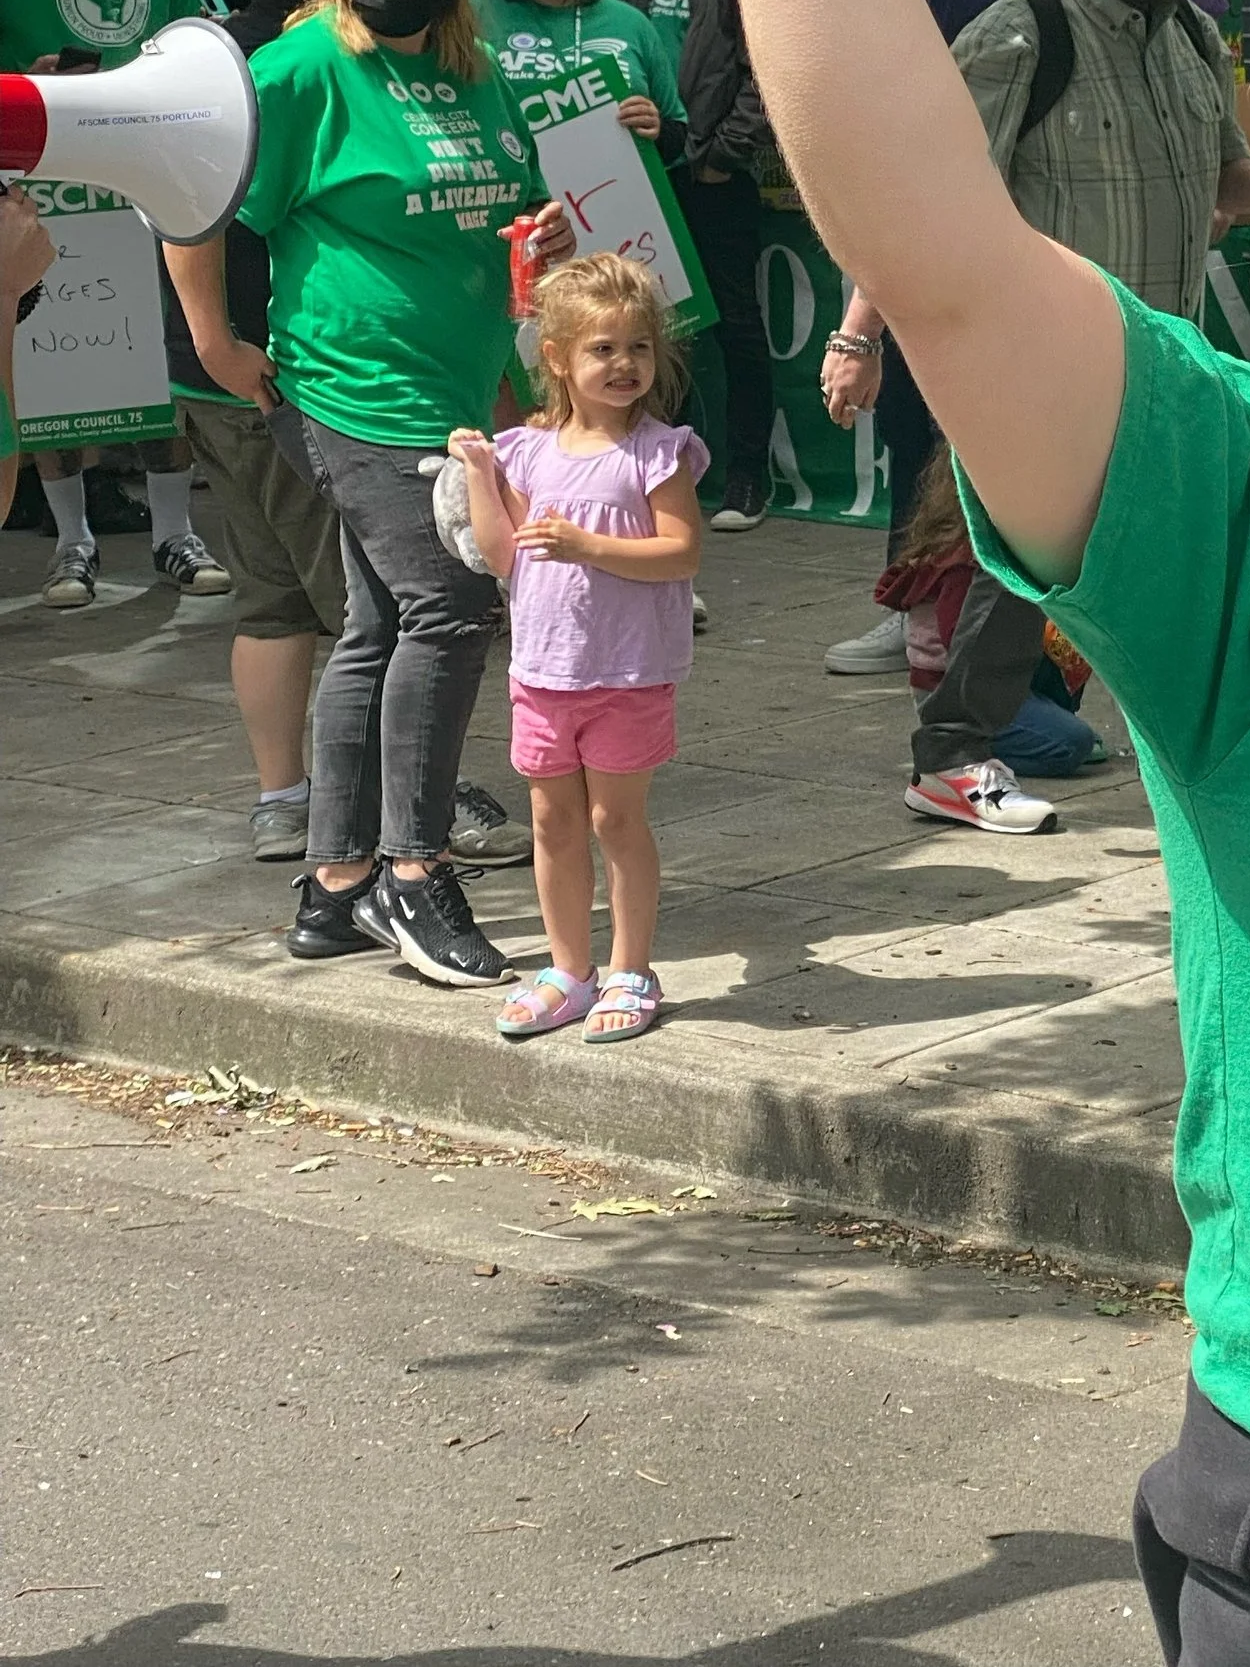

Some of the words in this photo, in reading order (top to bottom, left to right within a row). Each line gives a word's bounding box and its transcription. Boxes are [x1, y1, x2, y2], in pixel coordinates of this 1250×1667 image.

[77, 117, 111, 127] AFSCME
[112, 116, 149, 126] COUNCIL
[150, 115, 161, 124] 75
[162, 110, 212, 123] PORTLAND
[449, 109, 472, 121] CITY
[409, 120, 481, 136] CONCERN
[405, 193, 425, 216] A
[31, 316, 134, 353] NOW!
[20, 419, 70, 435] OREGON
[74, 414, 125, 429] COUNCIL
[128, 411, 143, 424] 75
